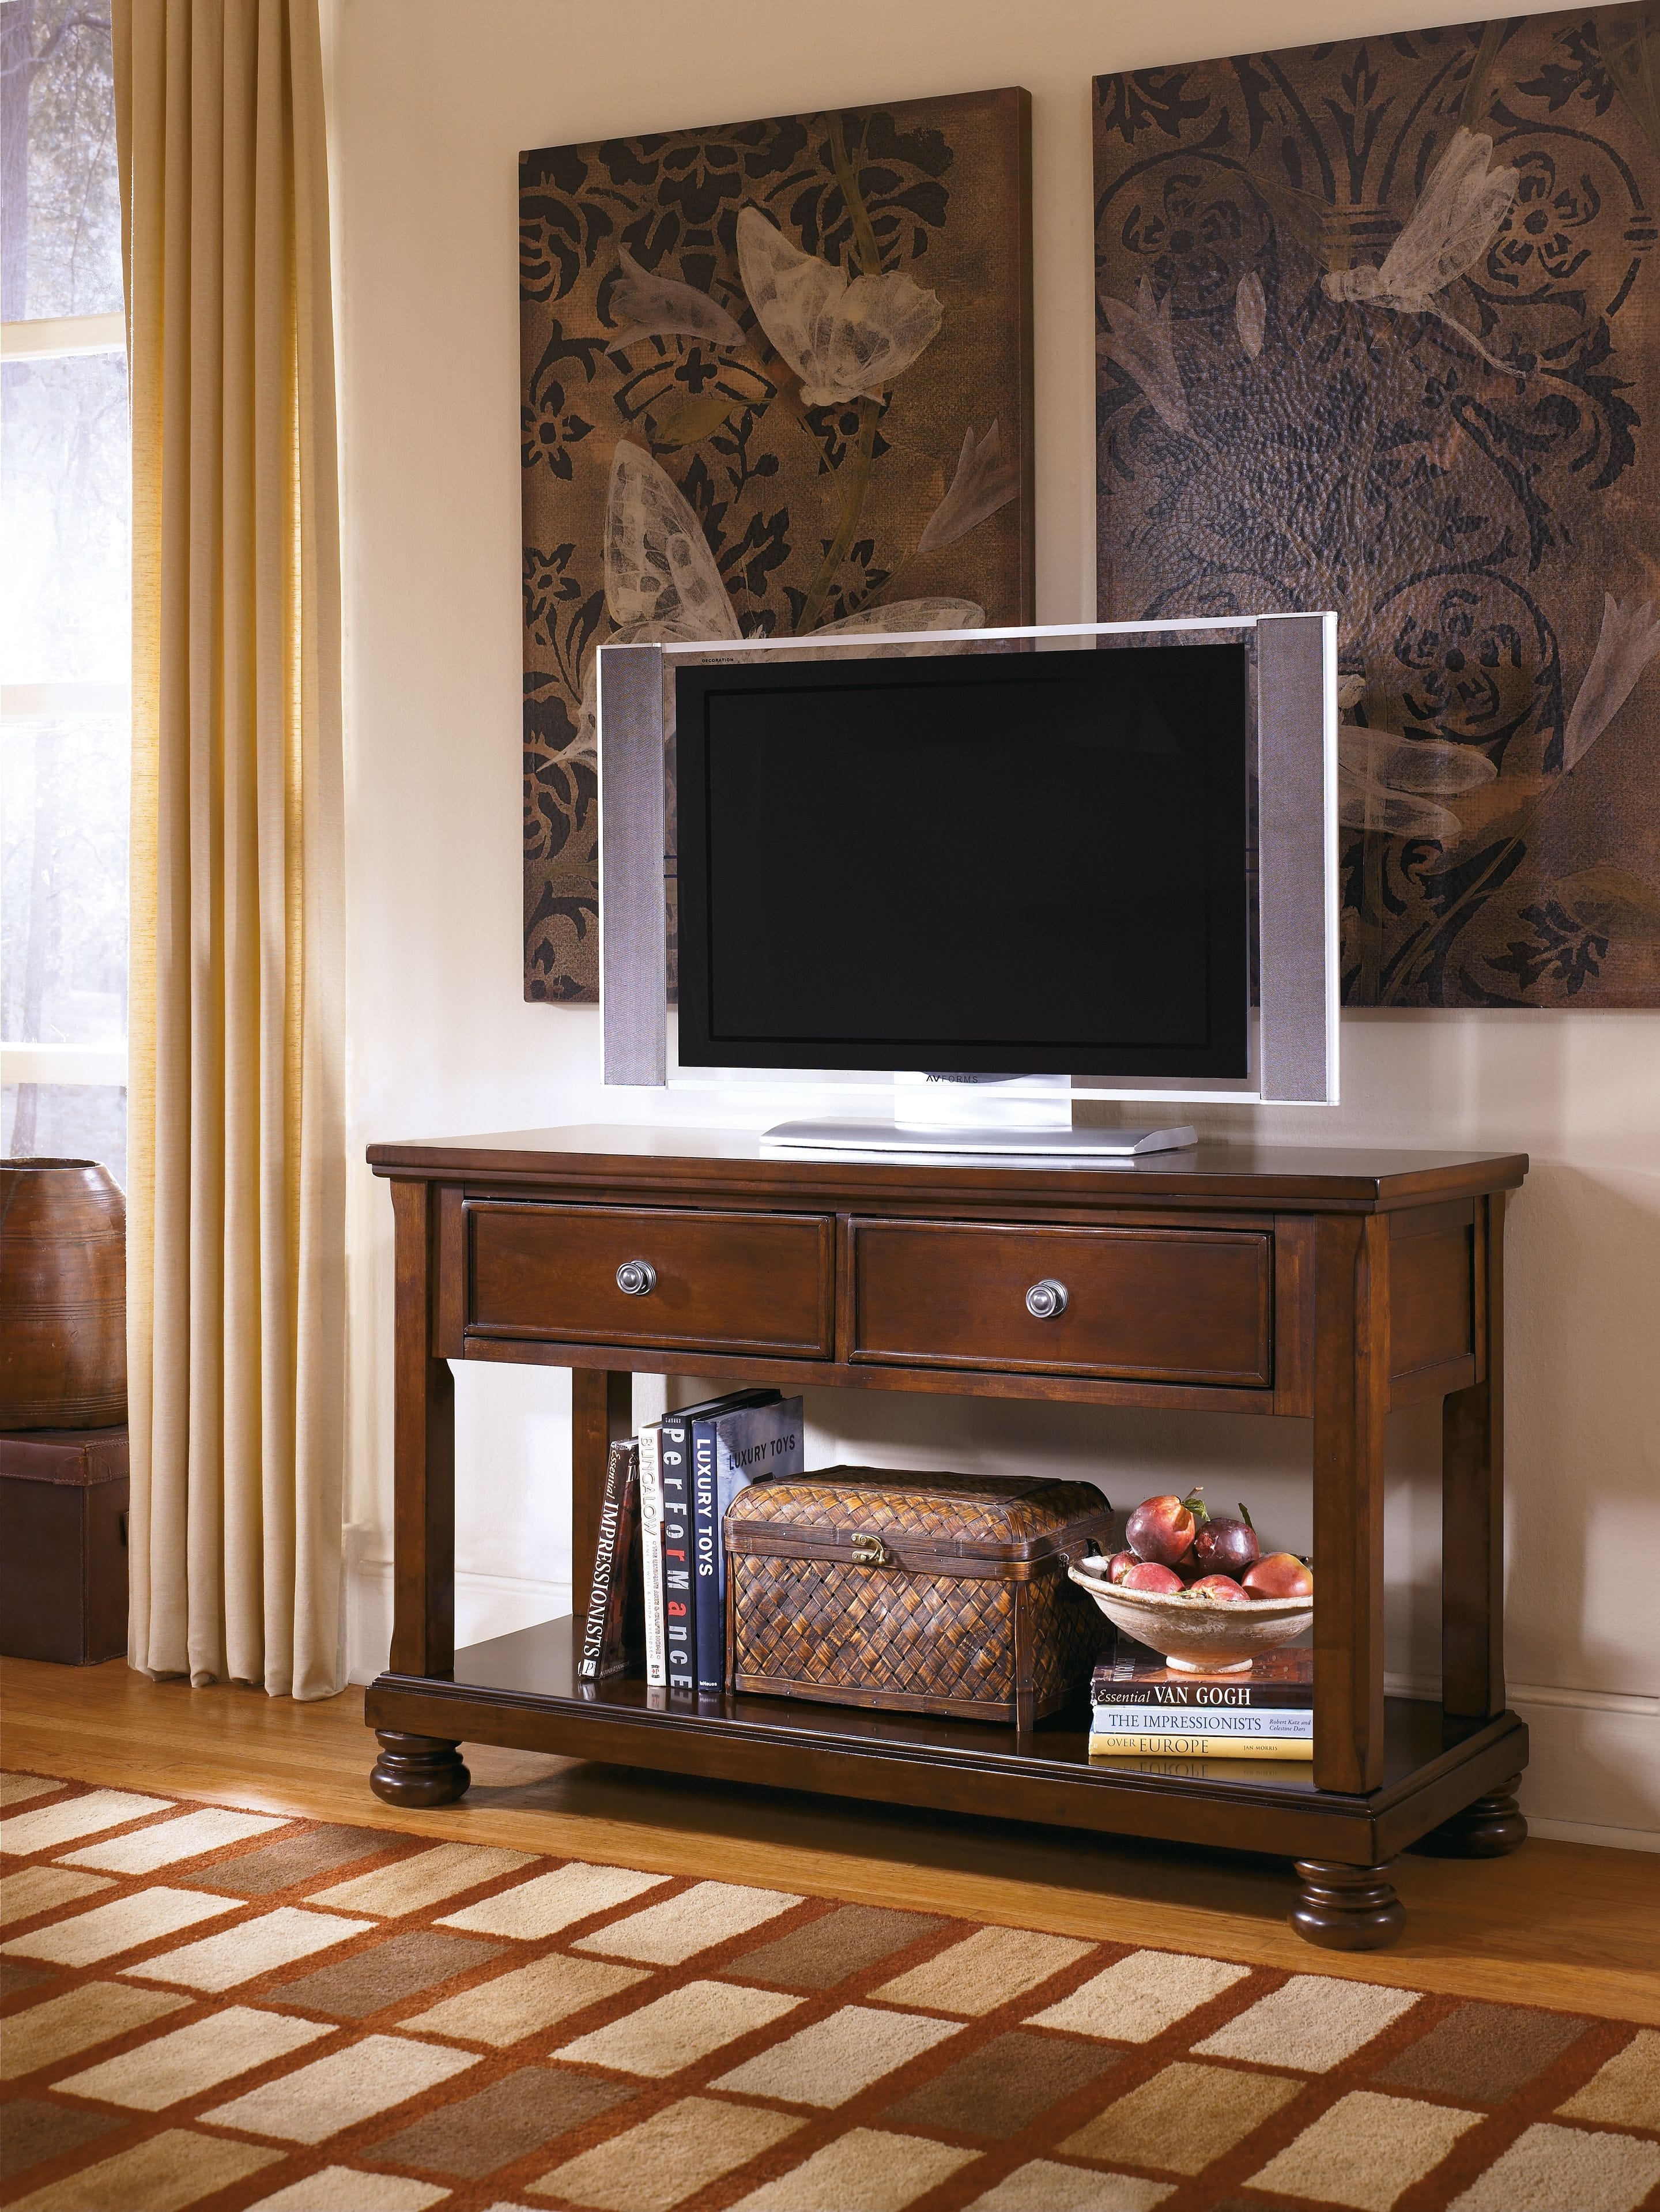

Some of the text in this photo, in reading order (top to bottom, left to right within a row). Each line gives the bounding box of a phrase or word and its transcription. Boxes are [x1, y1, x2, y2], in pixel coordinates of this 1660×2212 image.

[729, 1434, 795, 1470] LUXURY TOYS
[605, 1450, 621, 1499] Essential
[641, 1437, 657, 1536] BUNGALOW
[696, 1439, 714, 1576] LUXURY TOYS
[583, 1499, 619, 1657] IMPRESSIONISTS
[1115, 1658, 1135, 1672] GOGH
[1097, 1686, 1251, 1705] Essential VAN GOGH
[1109, 1714, 1262, 1730] THE IMPRESSIONISTS
[1107, 1738, 1136, 1747] OVER
[1140, 1738, 1209, 1754] EUROPE
